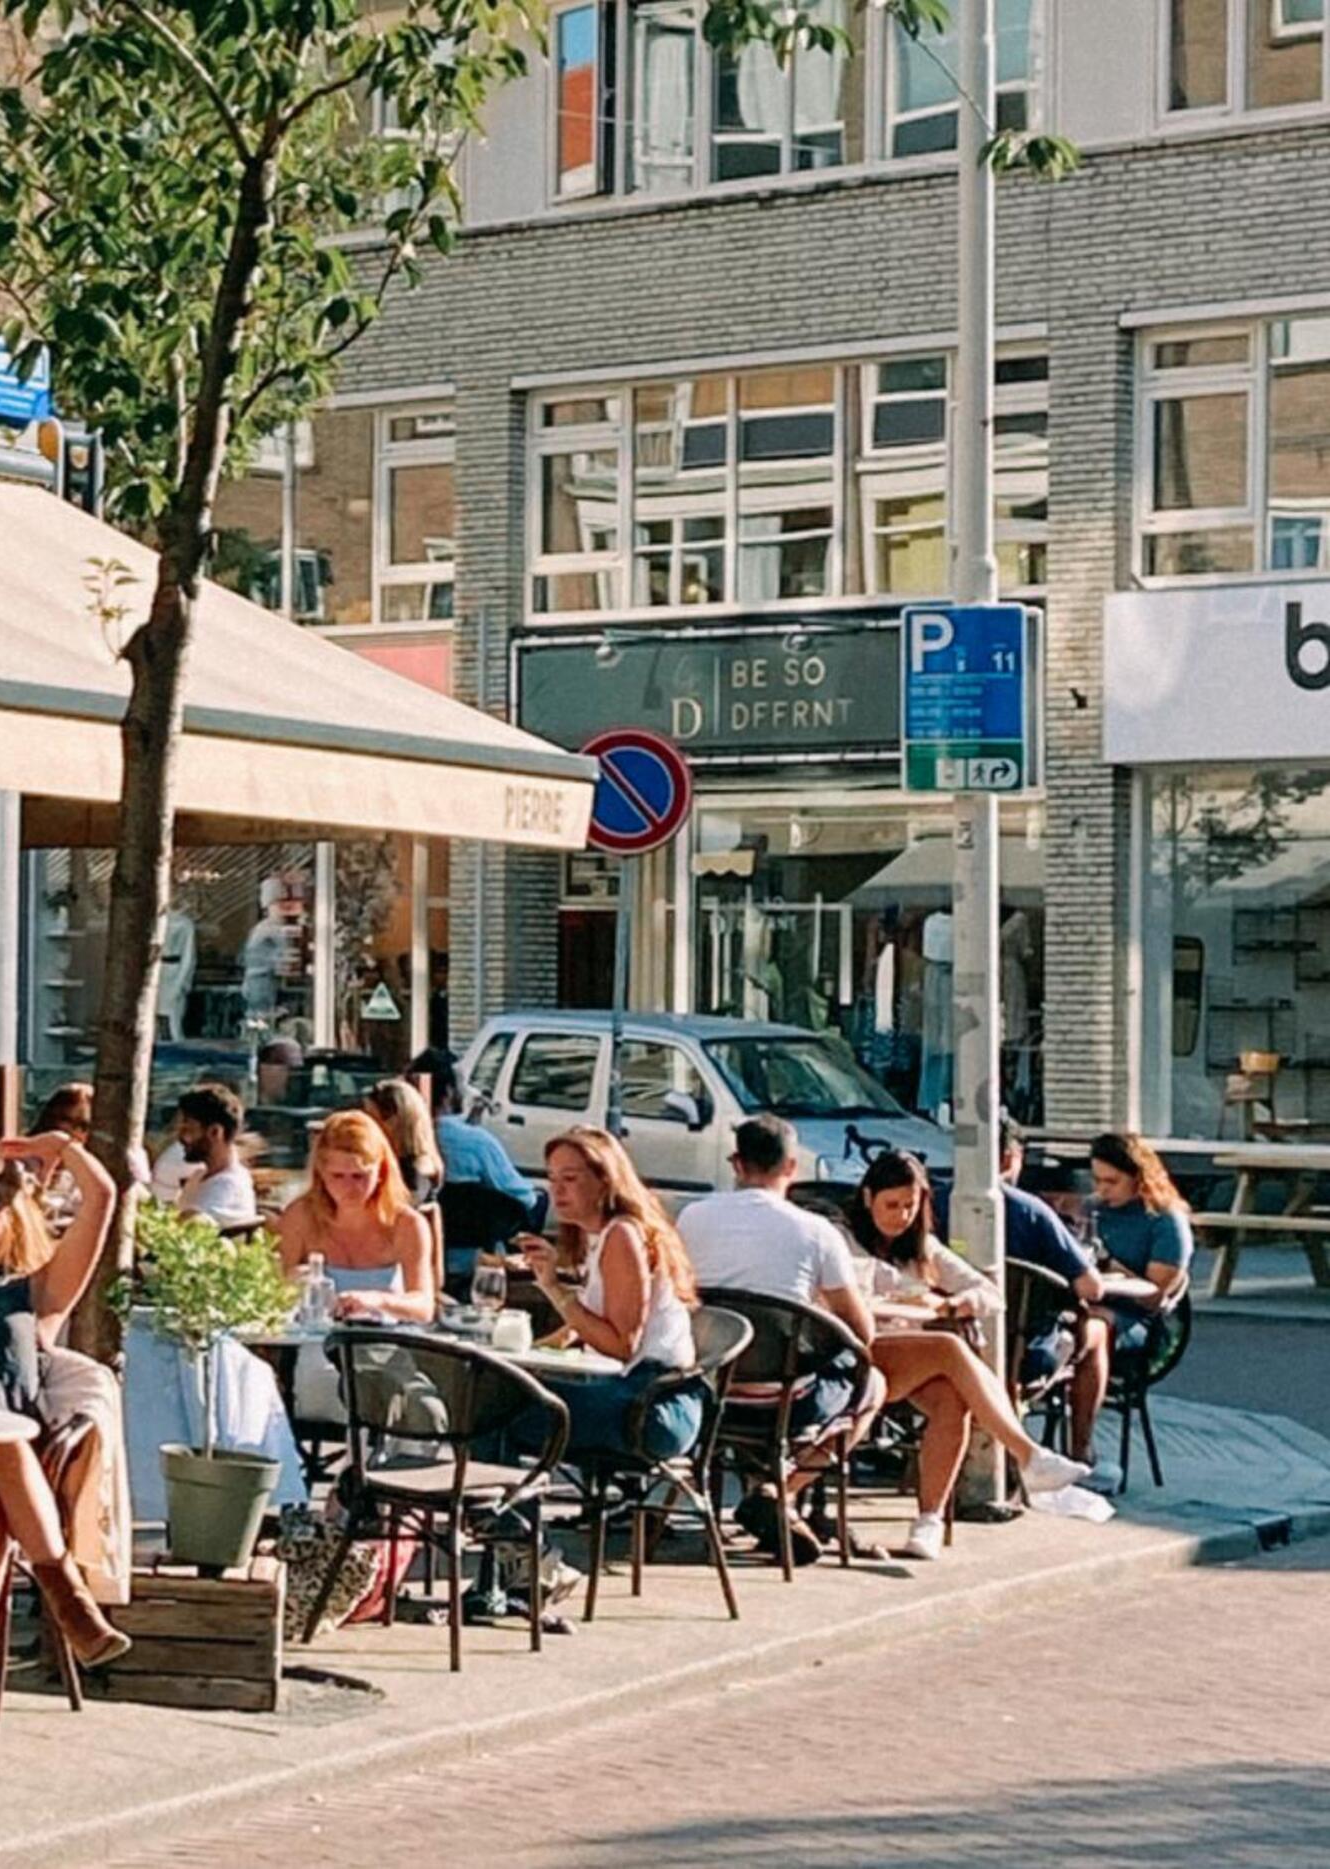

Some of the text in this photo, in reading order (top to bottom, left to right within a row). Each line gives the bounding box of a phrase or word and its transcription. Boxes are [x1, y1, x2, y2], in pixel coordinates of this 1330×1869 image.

[911, 613, 954, 673] P
[991, 651, 1015, 672] 11
[1285, 601, 1330, 690] b
[731, 656, 826, 688] BE SO
[671, 697, 703, 739] D
[731, 699, 854, 731] DFFRNT
[504, 785, 562, 834] PIERRE
